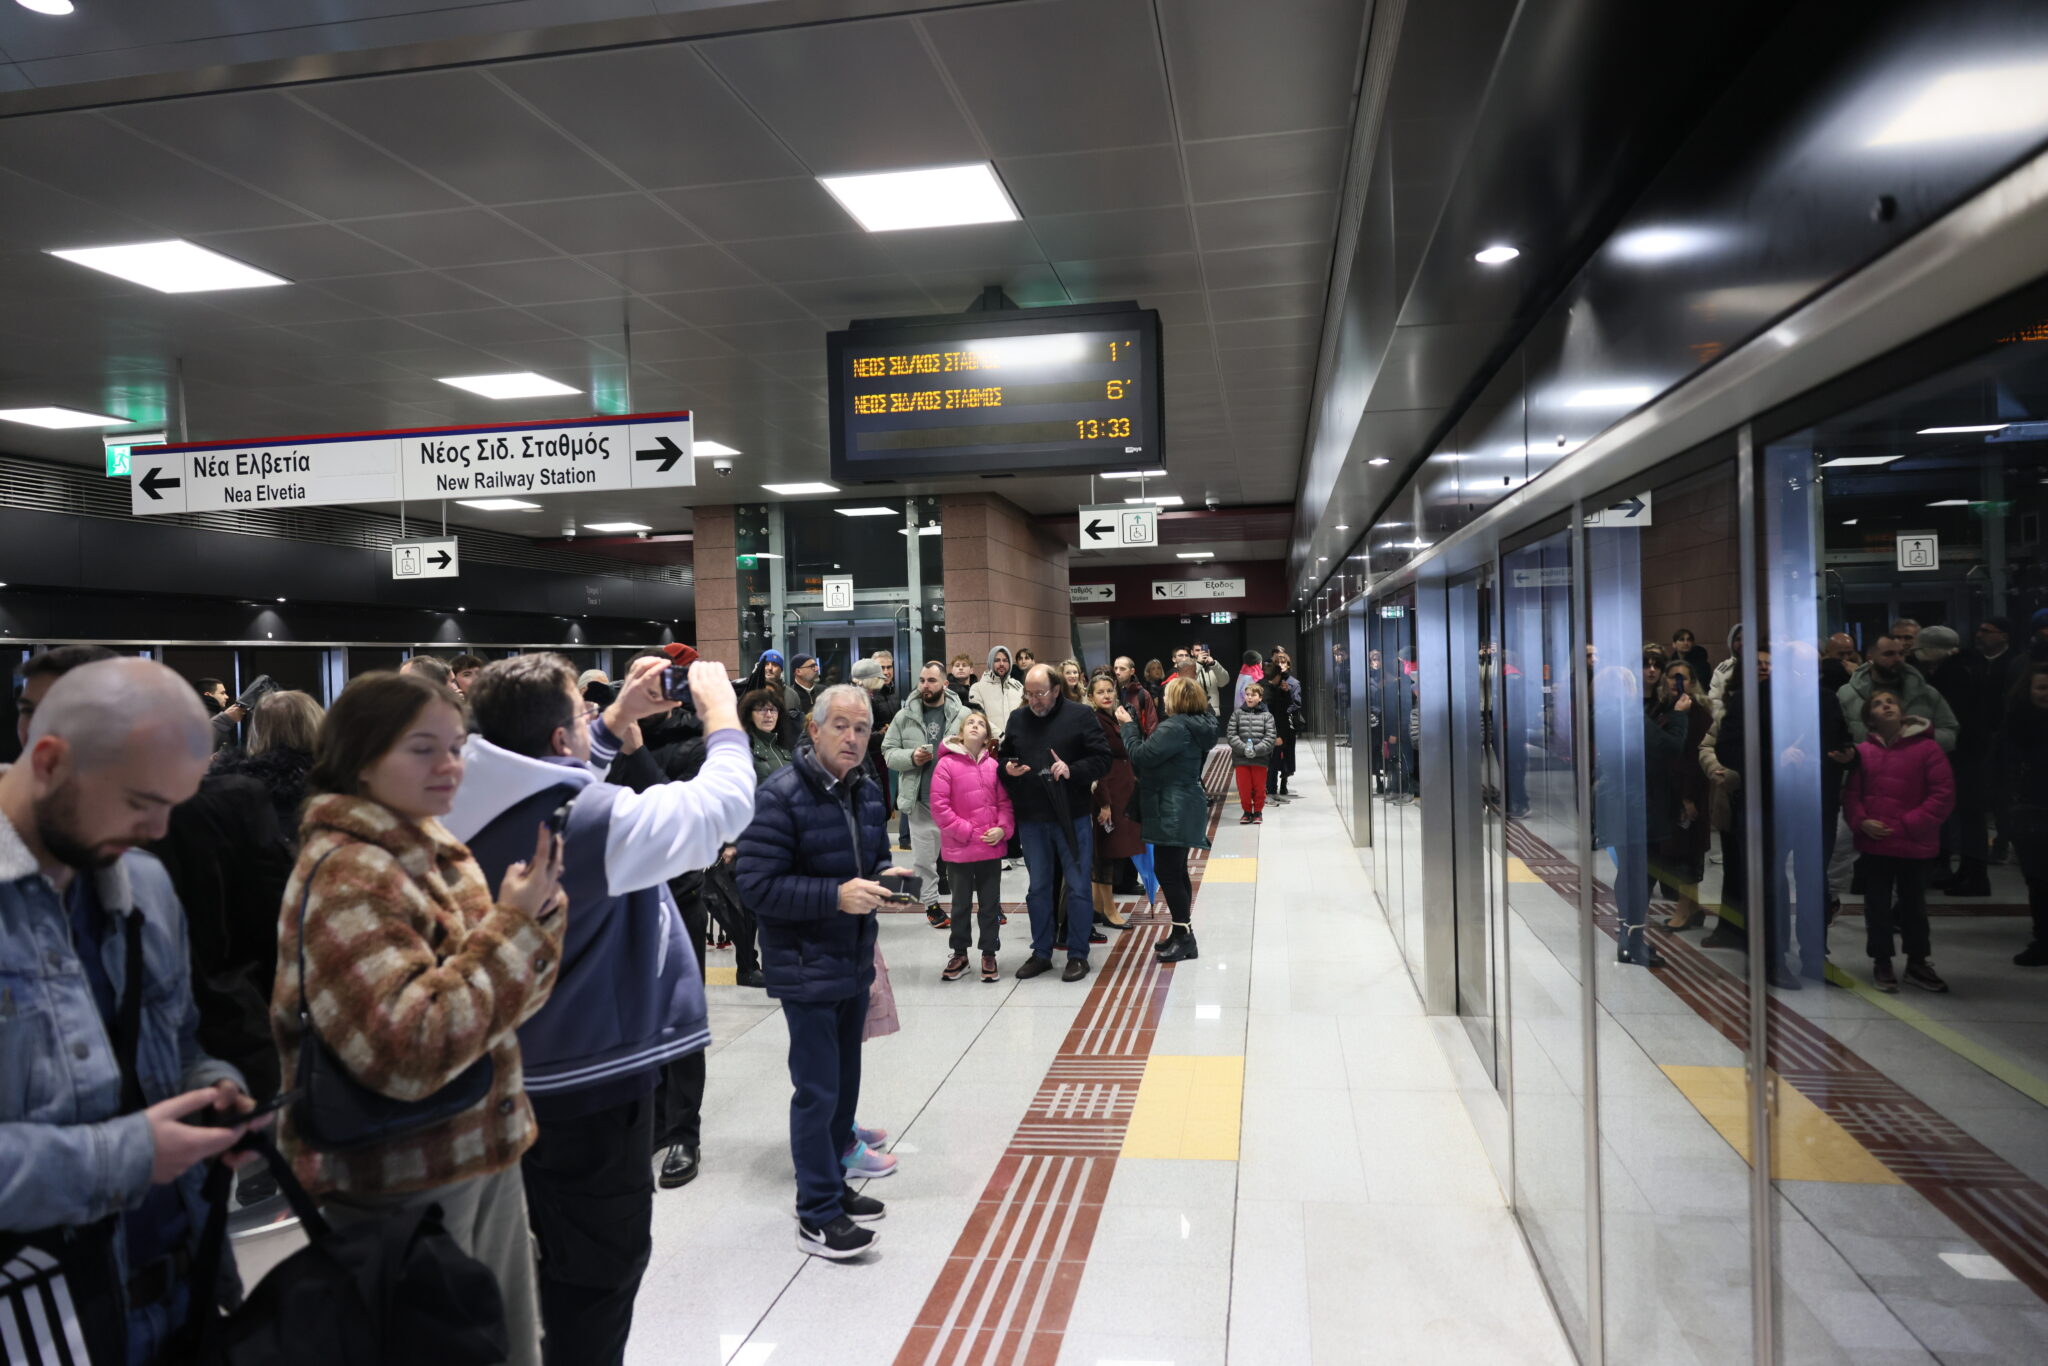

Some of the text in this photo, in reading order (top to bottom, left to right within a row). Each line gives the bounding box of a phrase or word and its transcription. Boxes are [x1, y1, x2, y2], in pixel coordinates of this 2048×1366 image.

[853, 357, 886, 378] ΝΕΟΣ
[889, 353, 941, 375] ΣΙΔ/ΚΟΣ
[944, 351, 1001, 372] ΣΤΑΘΜΟ
[854, 394, 887, 415] ΝΕΟΣ
[890, 390, 942, 412] ΣΙΔ/ΚΟΣ
[945, 386, 1002, 409] ΣΤΑΘΜΟΣ
[1076, 417, 1131, 440] 13:33
[420, 431, 610, 468] Νέος Σιδ. Σταθμός
[193, 450, 310, 480] Νέα Ελβετία
[436, 466, 596, 492] New Railway Station
[224, 483, 306, 503] Nea Elvetia
